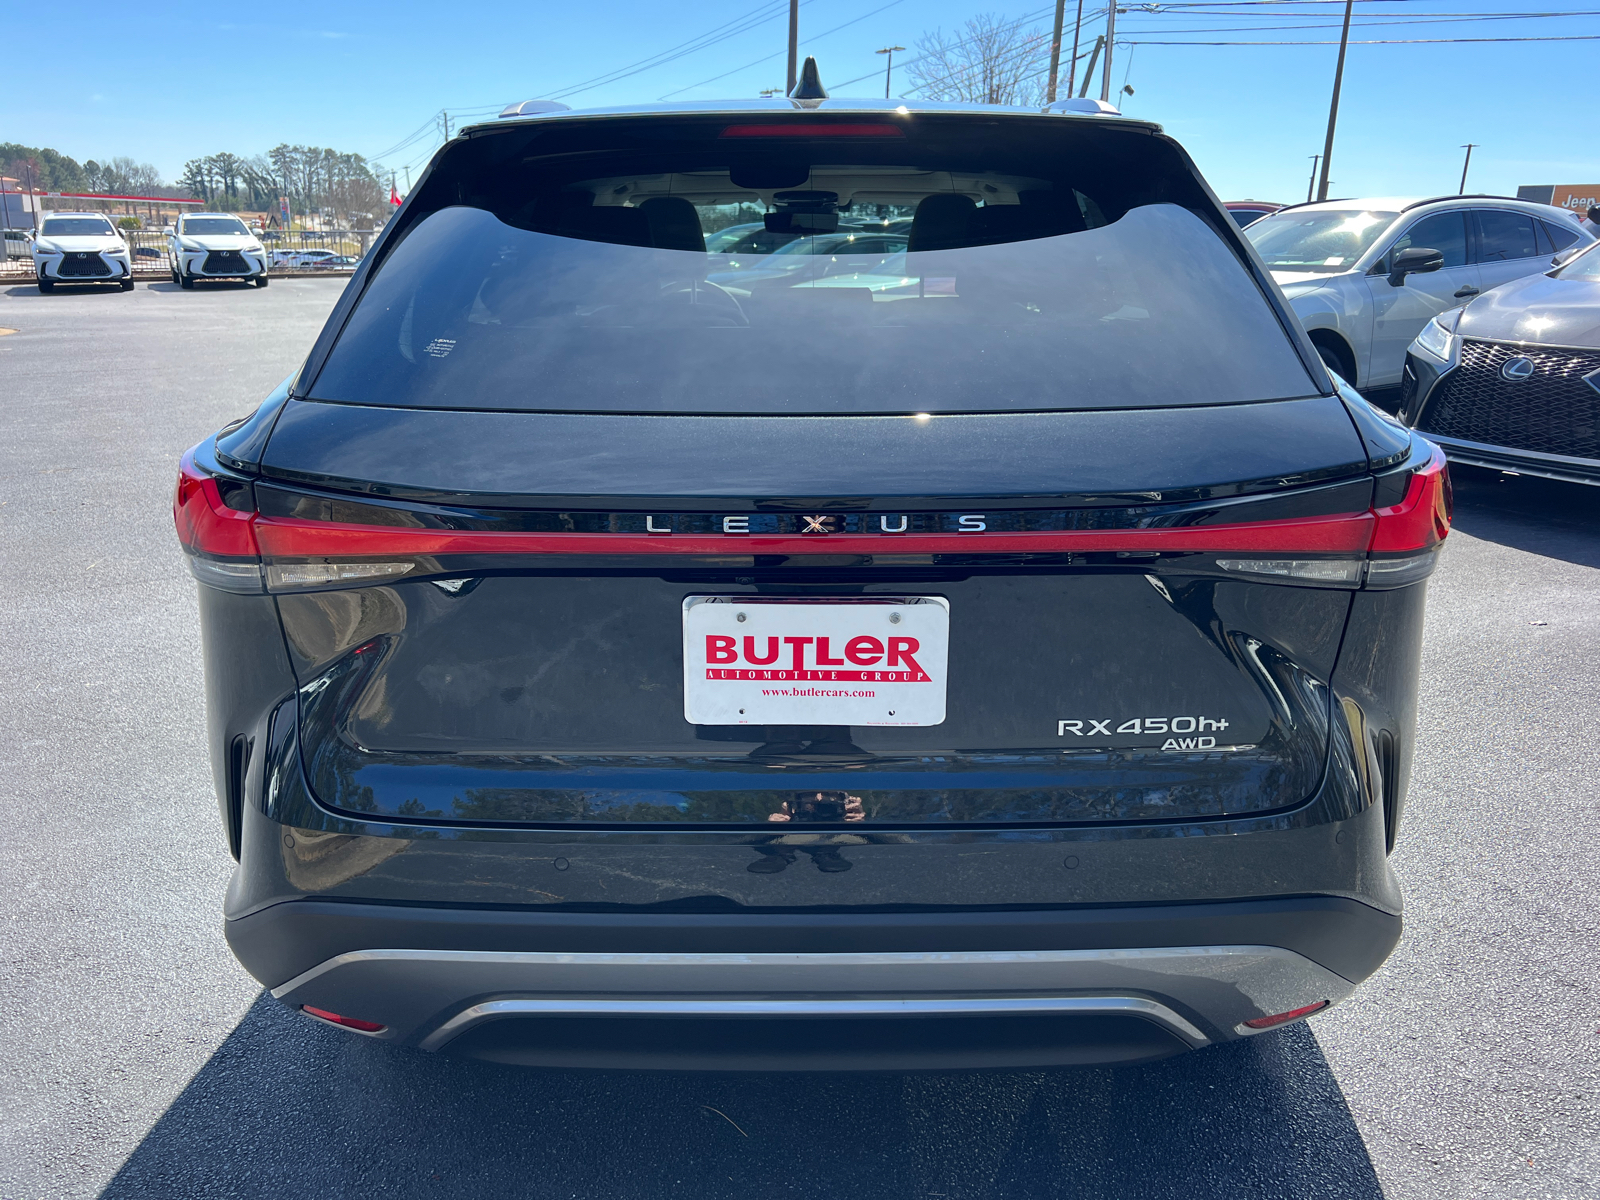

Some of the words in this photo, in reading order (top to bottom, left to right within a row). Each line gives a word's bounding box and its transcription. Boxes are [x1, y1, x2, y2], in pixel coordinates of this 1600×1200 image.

[1562, 194, 1596, 211] Jeep
[646, 515, 987, 533] LEXUS
[706, 669, 838, 680] AUTOMOTIVE
[861, 671, 925, 682] GROUP
[761, 687, 876, 699] www.butlercars.com
[1057, 719, 1112, 736] RX
[1161, 736, 1217, 751] AWD
